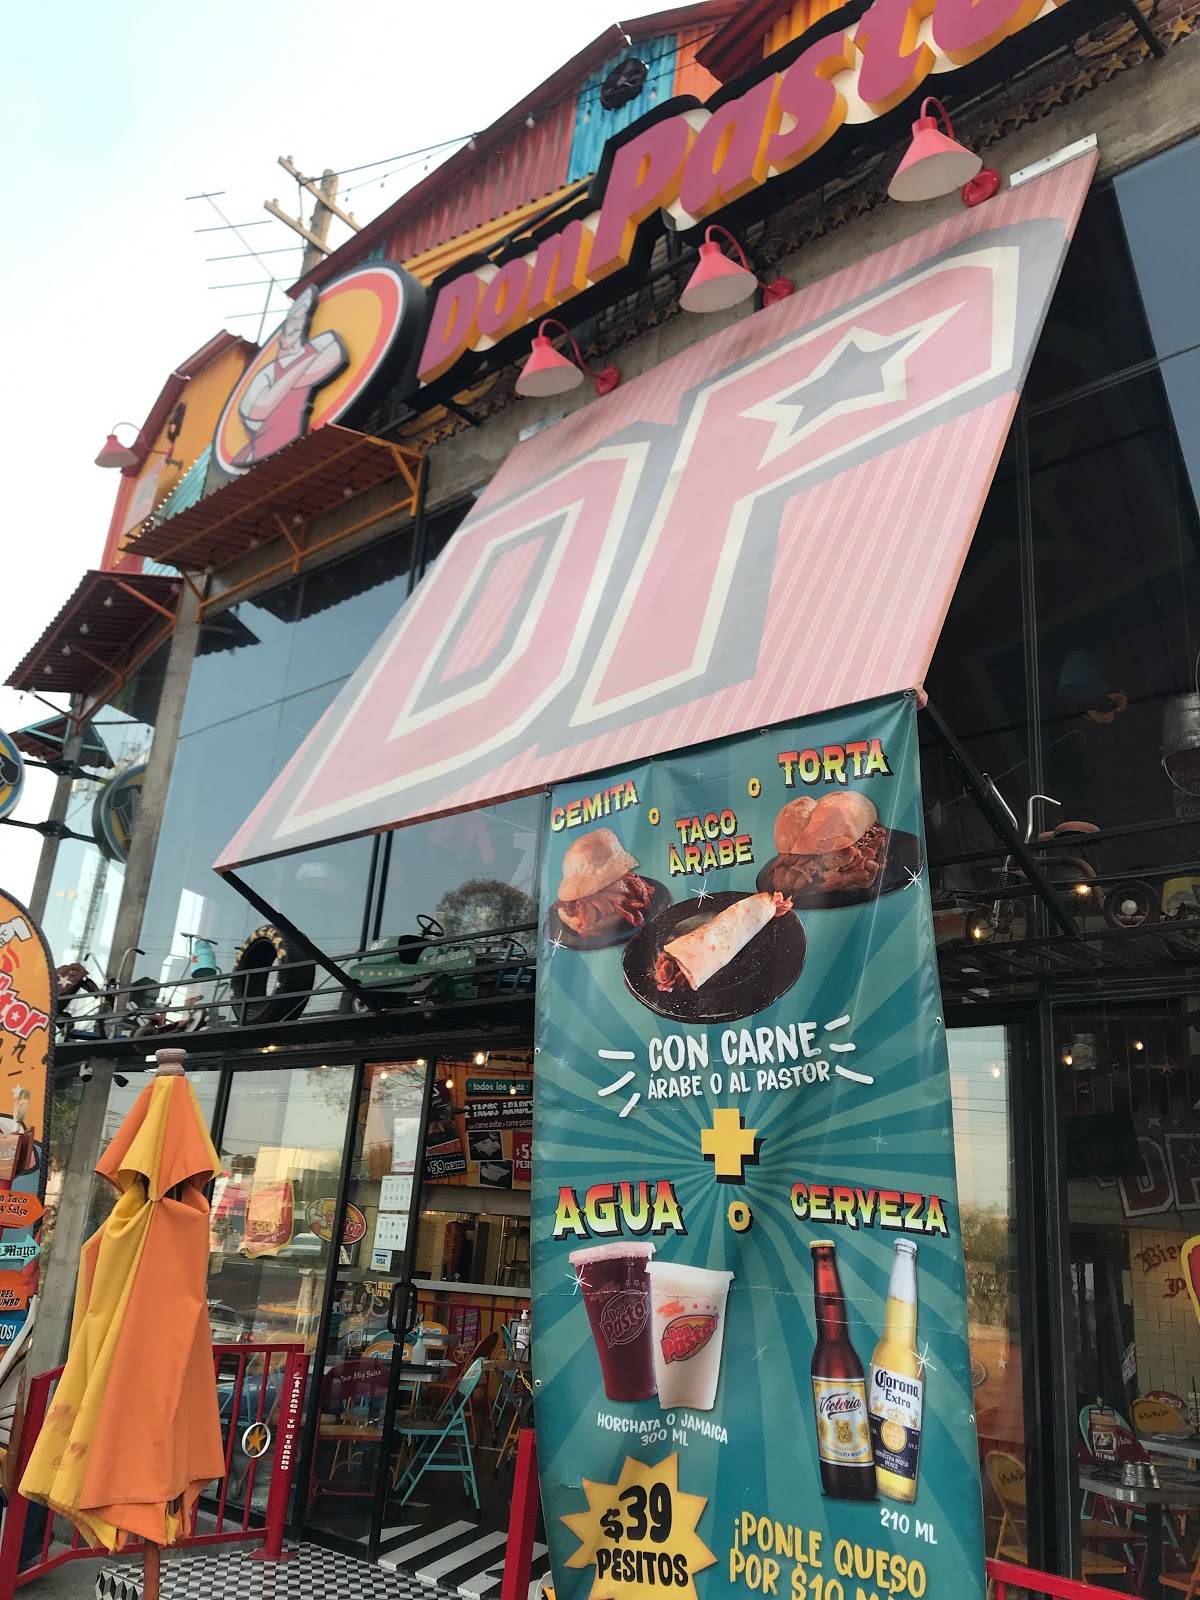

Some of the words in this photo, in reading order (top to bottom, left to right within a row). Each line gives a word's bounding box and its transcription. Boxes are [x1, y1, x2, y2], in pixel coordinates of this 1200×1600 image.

[417, 219, 594, 384] Don
[778, 738, 893, 788] TORTA
[550, 779, 640, 833] CEMITA
[675, 808, 738, 845] TACO
[648, 1033, 710, 1072] CON
[721, 1022, 822, 1066] CARNE
[648, 1072, 703, 1100] ÁRABE
[710, 1072, 723, 1095] O
[729, 1071, 751, 1094] AL
[757, 1060, 831, 1093] PASTOR
[7, 1193, 28, 1205] Taco
[7, 1205, 28, 1217] Salsa
[552, 1180, 688, 1241] AGUA
[788, 1182, 950, 1239] CERVEZA
[288, 1388, 300, 1414] APAGA
[875, 1368, 920, 1401] Corona
[885, 1388, 912, 1409] Extra
[286, 1418, 296, 1429] TU
[819, 1391, 863, 1421] Victoria
[596, 1411, 661, 1434] HORCHATA
[665, 1412, 676, 1427] O
[680, 1412, 729, 1445] JAMAICA
[640, 1429, 667, 1447] 300
[672, 1427, 689, 1447] ML
[280, 1434, 294, 1470] CIGARRO
[599, 1481, 673, 1544] $39
[879, 1507, 910, 1534] 210
[914, 1519, 938, 1545] ML
[595, 1547, 689, 1588] PESITOS
[729, 1547, 779, 1596] POR
[834, 1538, 927, 1599] QUESO
